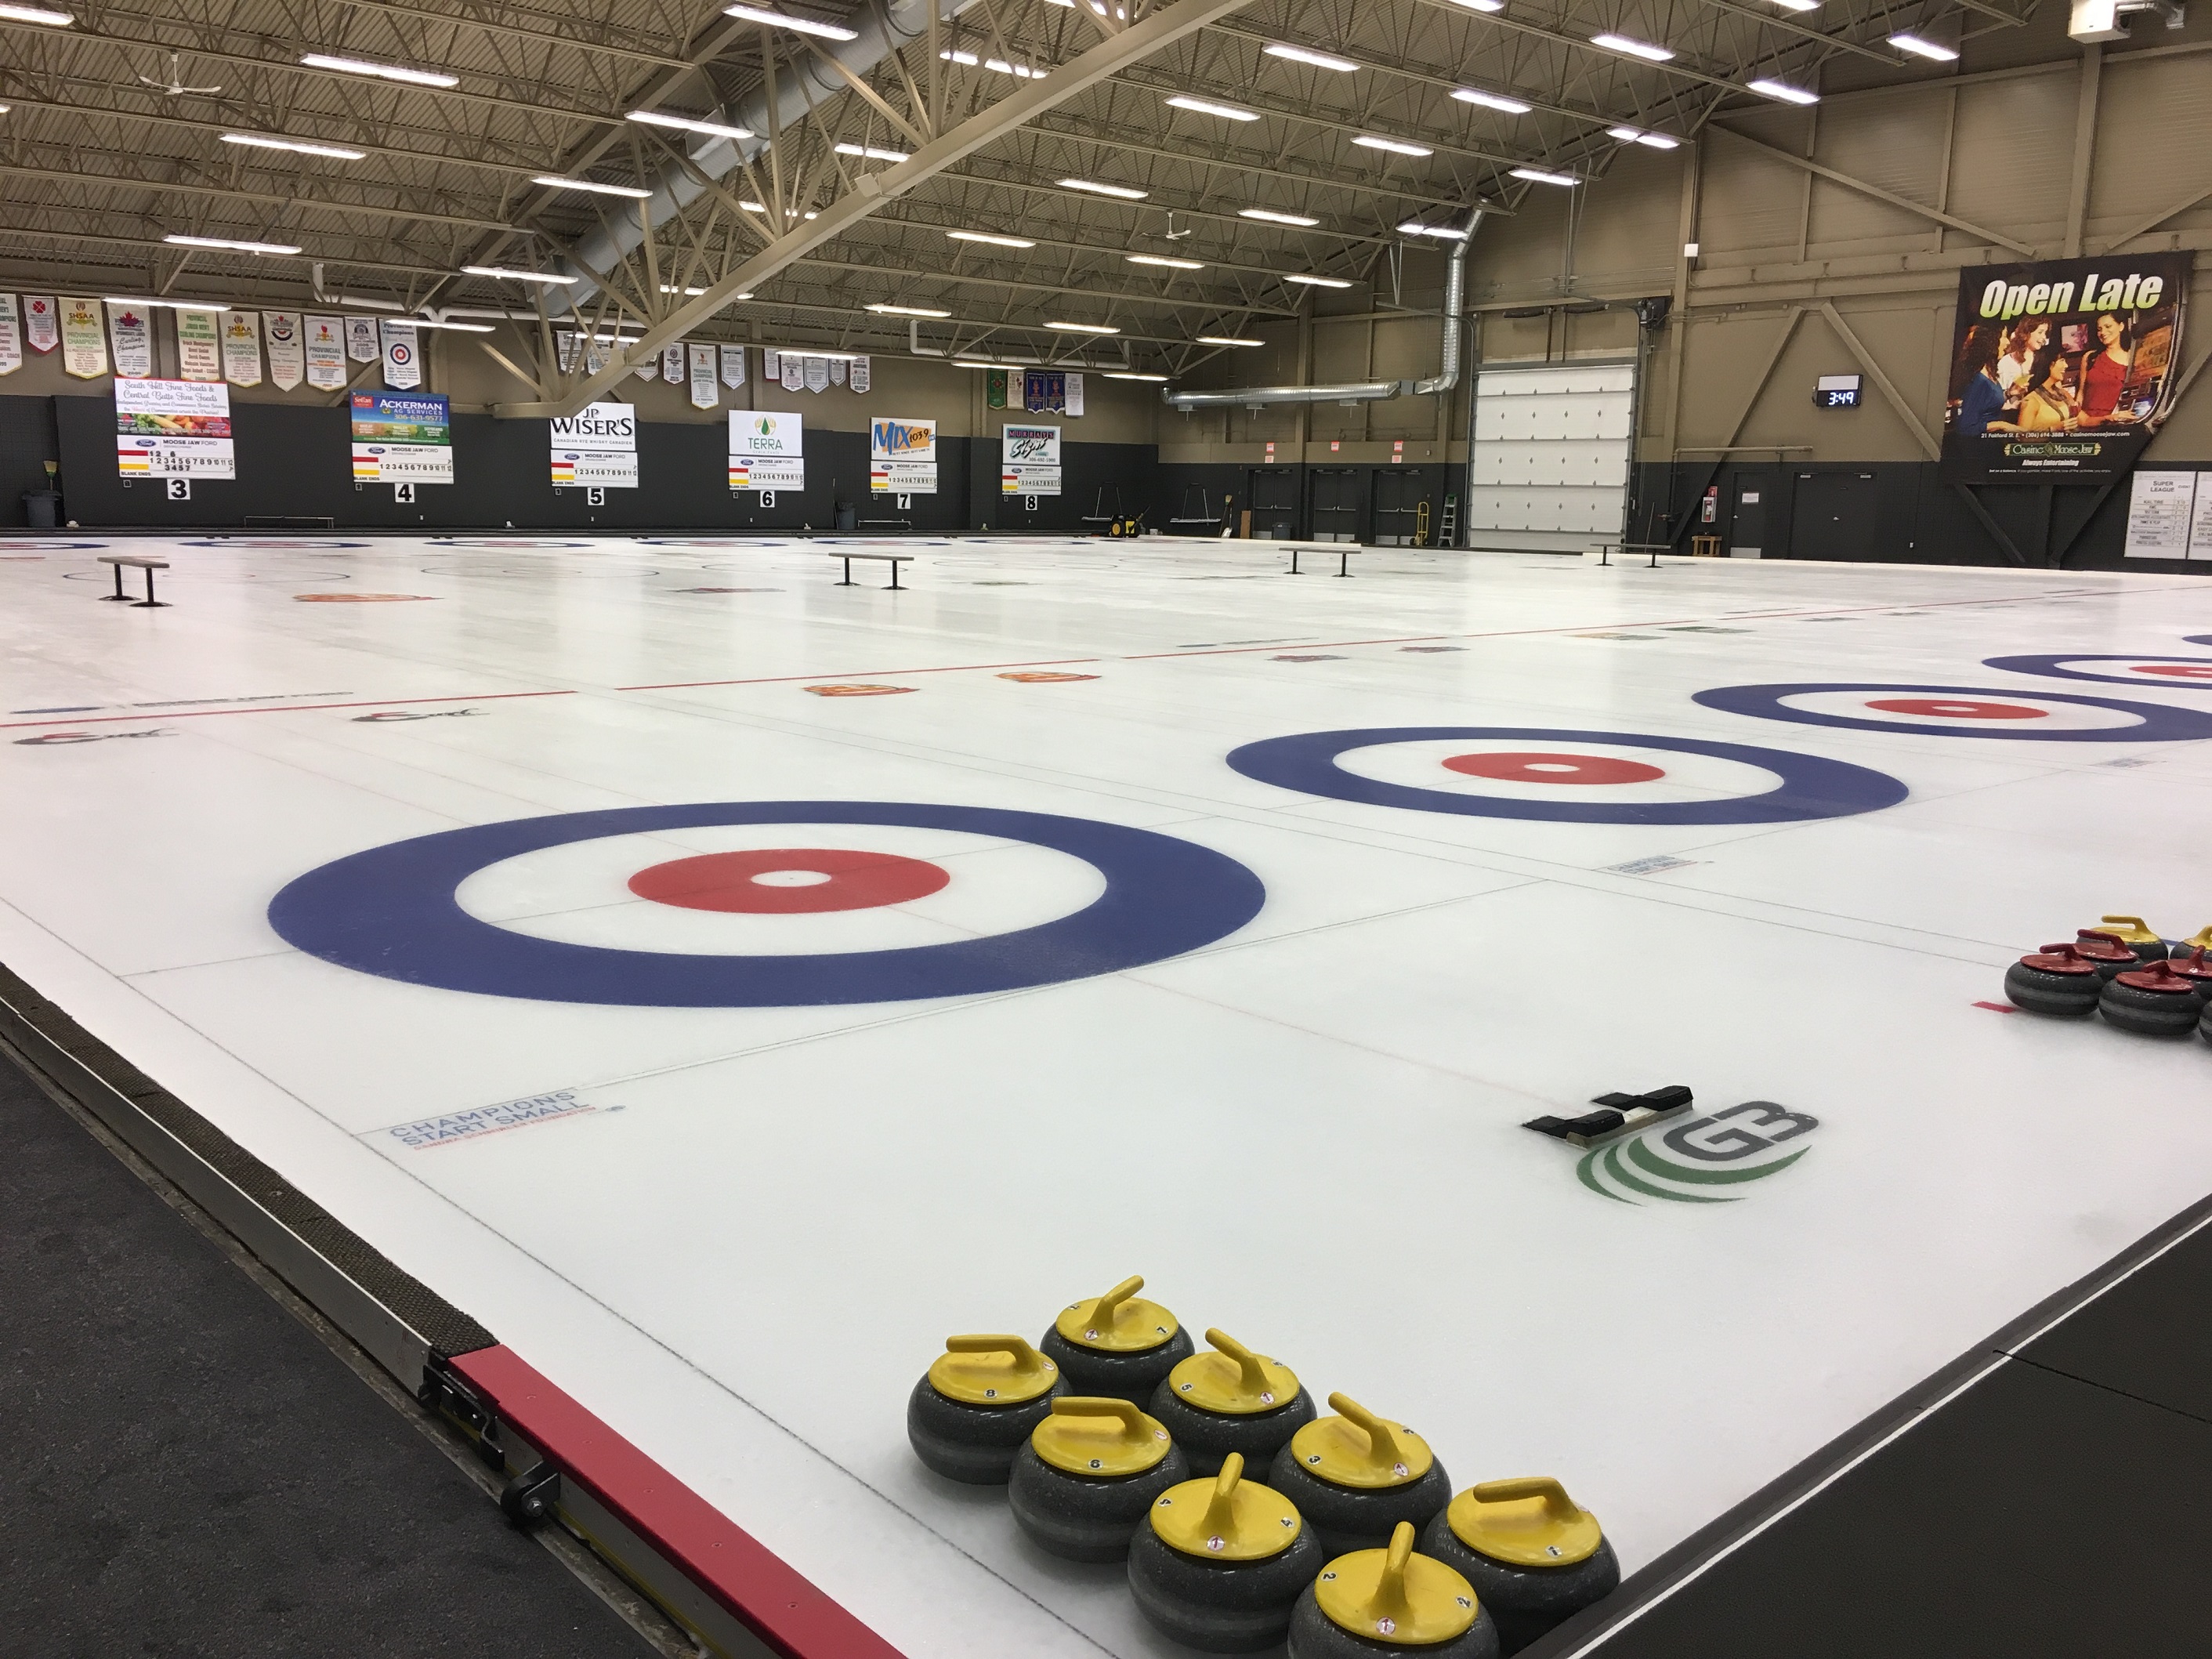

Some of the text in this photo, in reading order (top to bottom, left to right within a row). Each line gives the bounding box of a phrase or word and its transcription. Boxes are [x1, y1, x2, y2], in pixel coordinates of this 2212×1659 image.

[1979, 273, 2163, 321] Open Late
[125, 380, 145, 389] South
[147, 381, 164, 389] Hill
[165, 382, 183, 391] Fine
[184, 382, 207, 392] Foods
[124, 389, 217, 402] Central Butte Fine Foods
[1829, 392, 1854, 405] 3:49
[379, 399, 442, 411] ACKERMAN
[550, 418, 632, 436] WISER'S
[873, 422, 929, 456] MIX 103.9
[1009, 430, 1054, 439] MURRAYS
[748, 438, 783, 450] TERRA
[2013, 444, 2093, 454] Casino Moose Jaw
[171, 480, 187, 498] 3
[398, 484, 412, 502] 4
[590, 488, 602, 505] 5
[762, 491, 773, 506] 6
[900, 494, 908, 508] 7
[1027, 496, 1036, 509] 8
[390, 1092, 575, 1136] CHAMPIONS
[402, 1102, 589, 1146] START SMALL
[1663, 1100, 1819, 1162] G3
[1090, 1459, 1100, 1468] 6
[1457, 1596, 1471, 1607] 2
